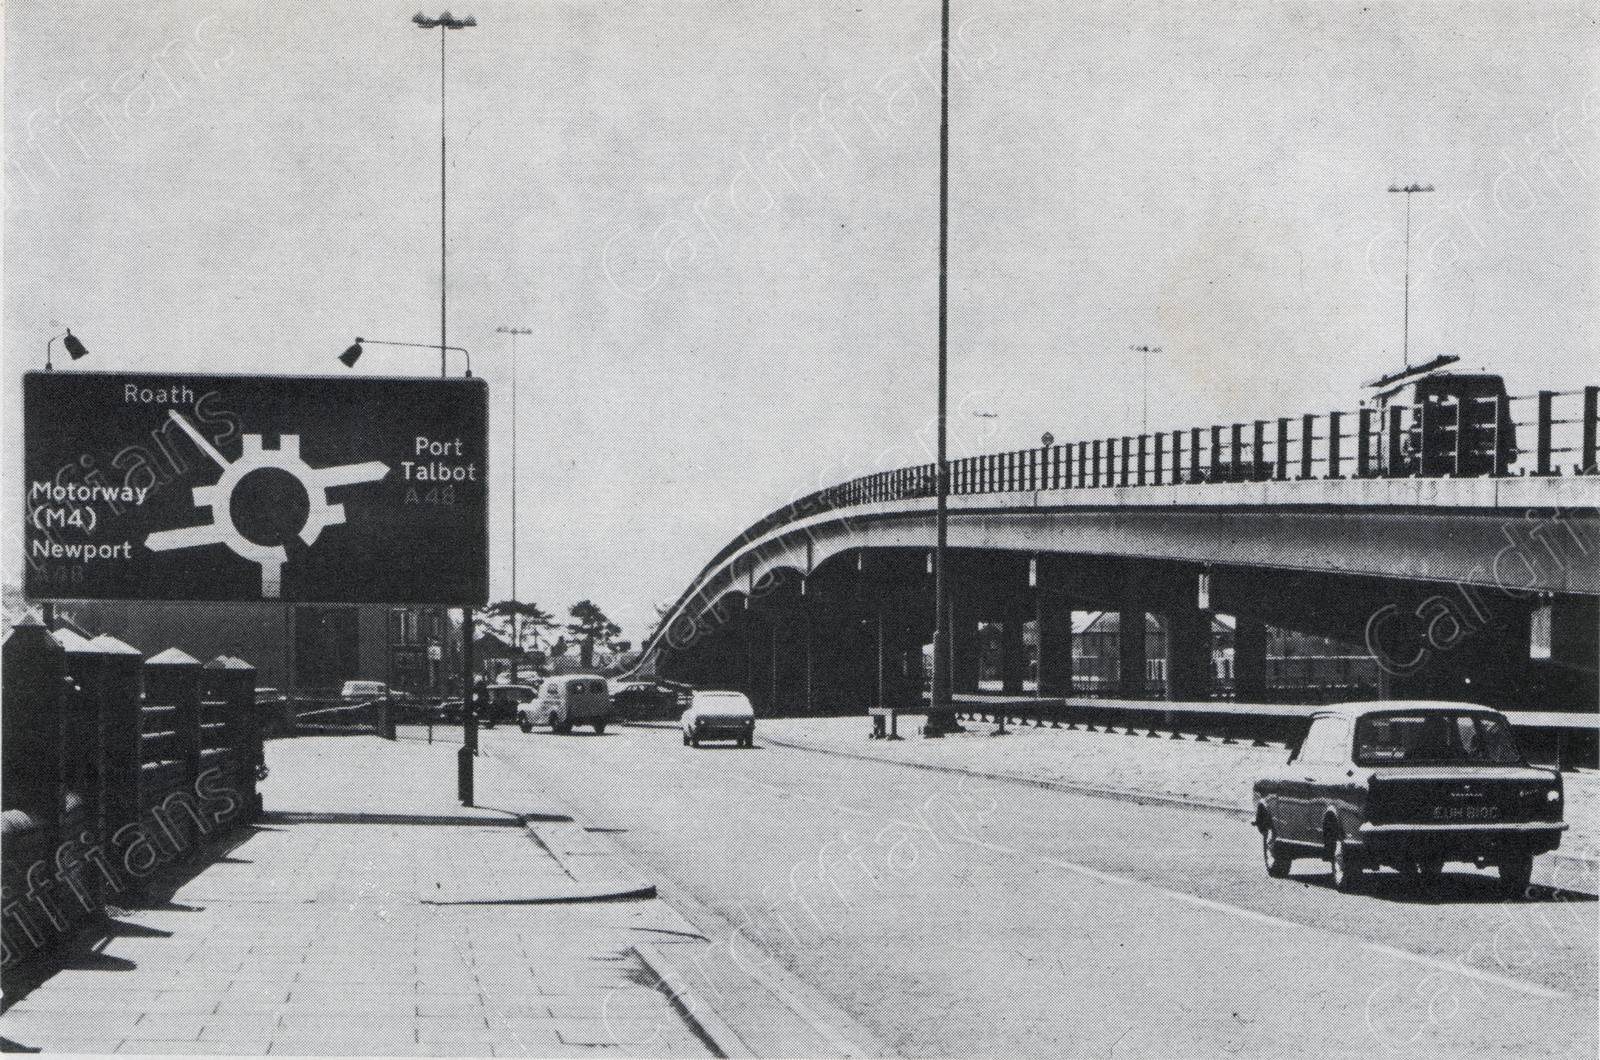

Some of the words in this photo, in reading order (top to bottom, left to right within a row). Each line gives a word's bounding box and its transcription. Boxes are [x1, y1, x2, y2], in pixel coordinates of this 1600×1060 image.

[124, 383, 195, 404] Roath
[415, 436, 463, 456] Port
[400, 461, 476, 481] Talbot
[32, 480, 147, 506] Motorway
[33, 505, 97, 531] (M4)
[32, 539, 132, 563] Newport
